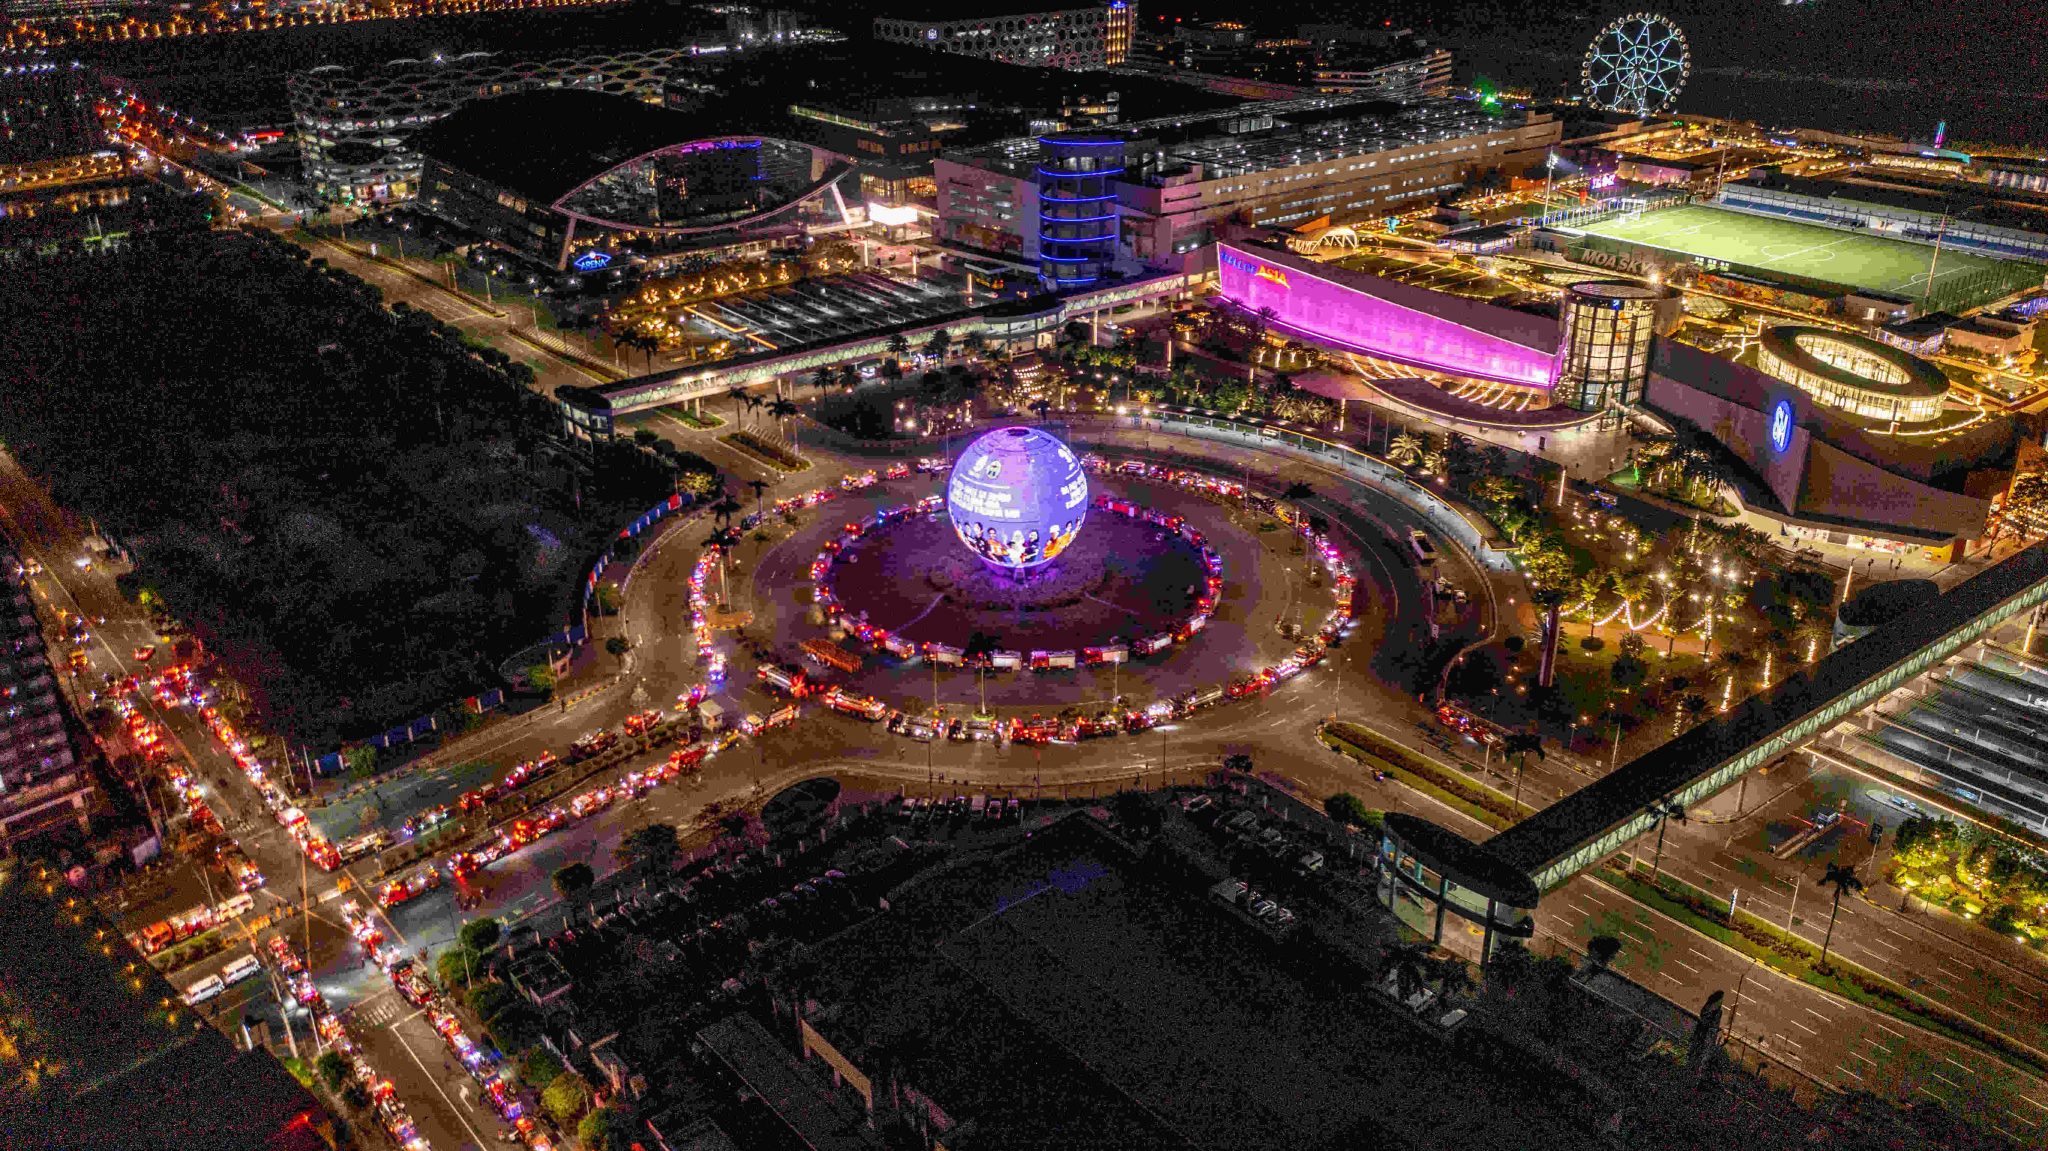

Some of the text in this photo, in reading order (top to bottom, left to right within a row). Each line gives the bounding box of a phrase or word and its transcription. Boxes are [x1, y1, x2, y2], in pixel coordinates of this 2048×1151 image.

[581, 259, 608, 270] ARENA
[1581, 248, 1657, 275] MOA SKY
[1259, 264, 1288, 284] ASIA
